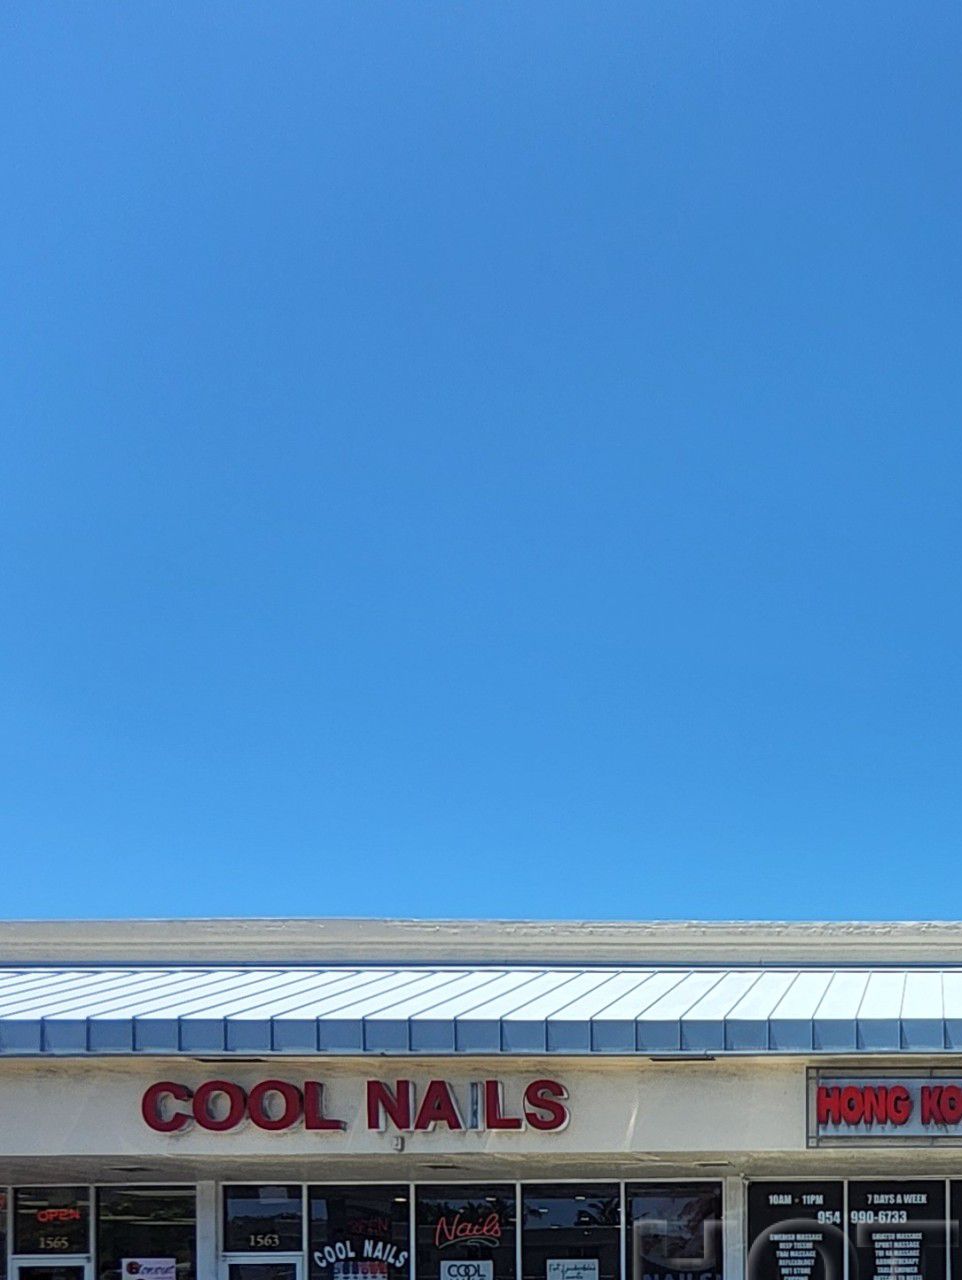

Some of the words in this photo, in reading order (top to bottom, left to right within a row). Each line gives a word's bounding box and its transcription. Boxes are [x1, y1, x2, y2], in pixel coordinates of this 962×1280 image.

[141, 1080, 347, 1133] COOL
[366, 1079, 569, 1132] NAILS
[817, 1085, 914, 1126] HONG
[769, 1194, 792, 1205] 10AM
[802, 1194, 824, 1205] 11PM
[866, 1194, 872, 1205] 7
[873, 1194, 895, 1204] DAYS
[896, 1194, 902, 1204] A
[903, 1194, 928, 1204] WEEK
[817, 1210, 841, 1224] 954
[850, 1210, 907, 1224] 990-6733
[435, 1213, 502, 1247] Nails
[39, 1237, 70, 1249] 1565
[249, 1233, 280, 1247] 1563
[313, 1240, 356, 1268] COOL
[363, 1239, 408, 1268] NAILS
[448, 1264, 486, 1277] COOL
